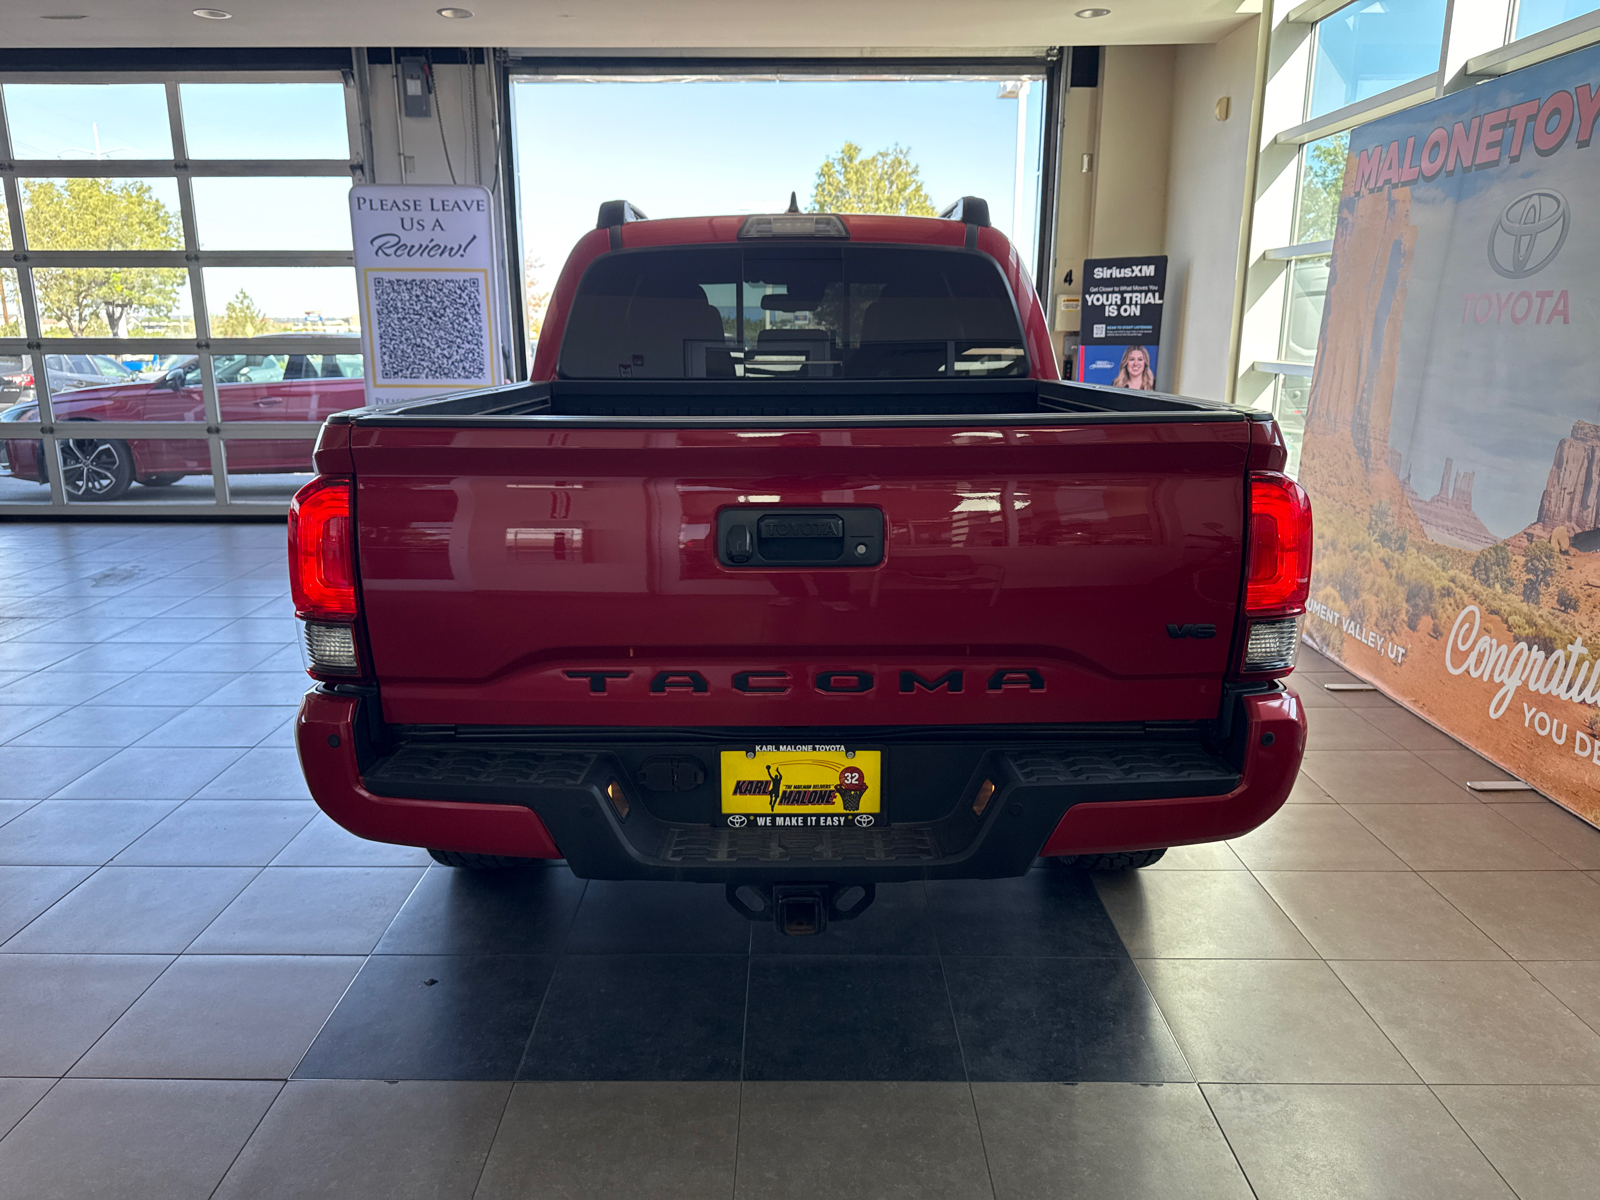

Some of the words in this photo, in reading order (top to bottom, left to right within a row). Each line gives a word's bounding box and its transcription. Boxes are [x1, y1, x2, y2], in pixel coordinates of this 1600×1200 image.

[356, 197, 422, 212] PLEASE
[429, 197, 485, 212] LEAVE
[431, 217, 446, 232] A
[369, 233, 477, 258] Review!
[1063, 269, 1073, 286] 4
[1093, 265, 1155, 279] SiriusXM
[1085, 293, 1121, 306] YOUR
[1123, 292, 1163, 304] TRIAL
[1105, 305, 1118, 317] IS
[1120, 304, 1141, 316] ON
[1461, 289, 1570, 325] TOYOTA
[765, 521, 838, 536] TOYOTA
[1166, 624, 1217, 639] V6
[1304, 597, 1340, 627] UMENT
[1342, 616, 1385, 656] VALLEY,
[1387, 641, 1406, 664] UT
[562, 668, 1047, 696] TACOMA
[1523, 702, 1567, 745] YOU
[844, 772, 859, 784] 32
[732, 780, 772, 796] KARL
[778, 790, 838, 806] MALONE
[756, 816, 772, 826] WE
[776, 816, 804, 826] MAKE
[808, 816, 816, 826] IT
[820, 816, 845, 826] EASY
